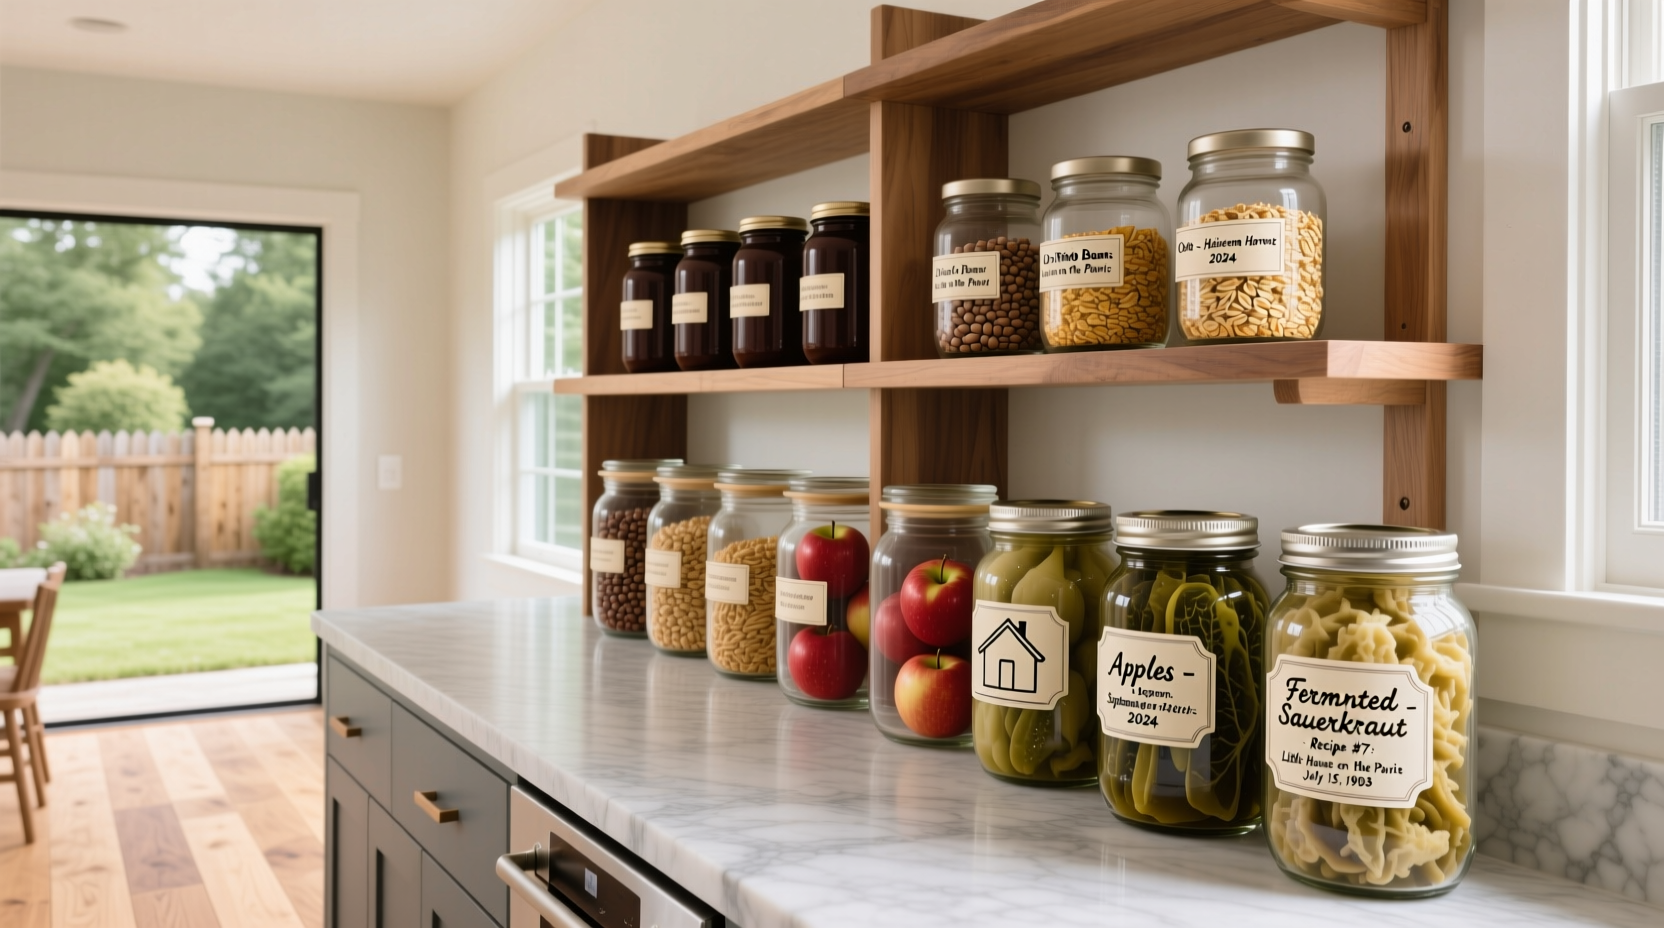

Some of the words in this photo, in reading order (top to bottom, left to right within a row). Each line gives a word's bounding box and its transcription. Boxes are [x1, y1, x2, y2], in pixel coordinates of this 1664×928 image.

[1209, 252, 1237, 264] 2024
[1108, 651, 1174, 687] Apples
[1127, 712, 1159, 729] 2024
[1278, 703, 1407, 737] Sauerkraut
[1310, 737, 1347, 756] Recipe
[1346, 775, 1373, 787] 1903
